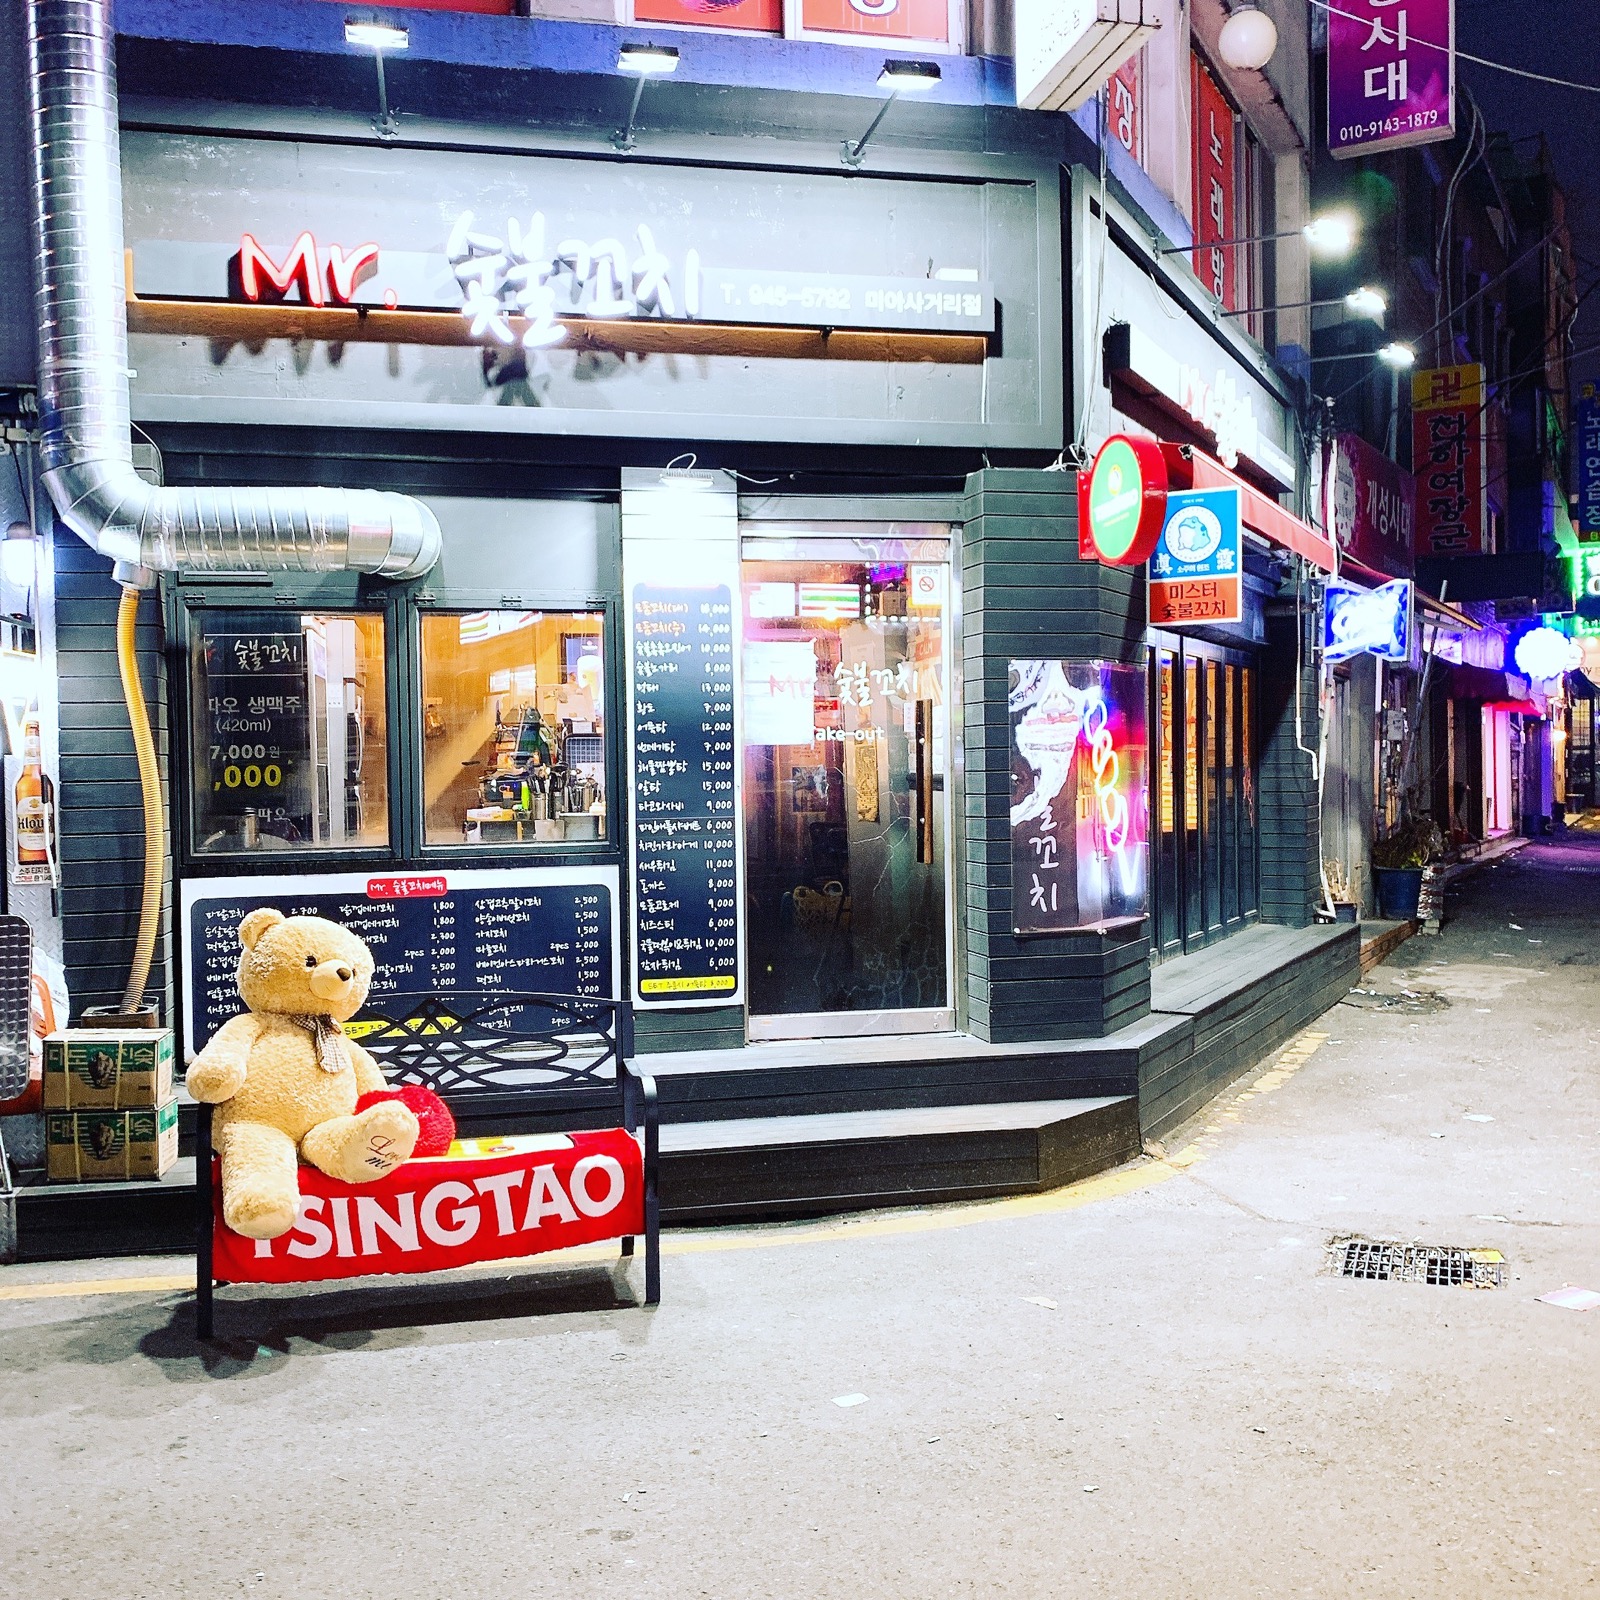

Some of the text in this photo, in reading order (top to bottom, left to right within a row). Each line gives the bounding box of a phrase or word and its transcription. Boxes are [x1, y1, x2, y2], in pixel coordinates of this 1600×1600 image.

[1360, 0, 1408, 101] 시대
[1339, 109, 1438, 141] 010-9143-1879
[241, 210, 700, 348] Mr. 숯불꼬치
[864, 288, 983, 317] 미아사거리점
[1366, 479, 1411, 548] 개성시대
[1169, 582, 1217, 599] 미스터
[1161, 600, 1226, 620] 숯불꼬치
[234, 640, 297, 672] 숯불꼬치
[701, 643, 730, 656] 10,000
[834, 661, 918, 707] 숯불꼬치
[247, 696, 303, 715] 생맥주
[636, 700, 731, 716] 황도 7,000
[215, 719, 272, 733] (420ml)
[637, 721, 731, 736] 어묵탕 12,000
[814, 726, 886, 741] ake-out
[637, 740, 731, 755] 번데기탕 7,000
[637, 760, 732, 776] 해물짬뽕탕 15,000
[214, 764, 282, 792] ,000
[637, 780, 732, 796] 알탕 15,000
[638, 800, 732, 813] 타코와사비 9,000
[18, 816, 53, 829] Klou
[707, 820, 732, 834] 6,000
[639, 840, 733, 852] 치킨가라아게 10,000
[639, 860, 733, 872] 새우튀김 11,000
[370, 879, 444, 895] Mr. 숯불꼬치메뉴
[639, 879, 734, 894] 돈까스 8,000
[433, 902, 454, 913] 1,800
[475, 896, 598, 910] 삼겹고추말이꼬치 2,500
[708, 899, 734, 912] 9,000
[205, 908, 245, 921] 파닭꼬치
[475, 911, 598, 925] 양송이버섯꼬치 2,500
[433, 917, 455, 928] 1,800
[640, 918, 734, 931] 치즈스틱 6,000
[475, 926, 598, 938] 가지꼬치 1,500
[475, 941, 599, 956] 마늘꼬치 2pcs 2,000
[706, 938, 734, 951] 10,000
[404, 947, 455, 959] 2pcs 2,000
[431, 963, 455, 974] 2,500
[575, 956, 599, 967] 2,500
[641, 957, 735, 971] 감자튀김 6,000
[578, 970, 599, 982] 1,500
[432, 978, 455, 989] 3,000
[576, 985, 599, 997] 3,000
[207, 1003, 240, 1015] 새우꼬치
[552, 1017, 570, 1026] 2pcs
[344, 1026, 365, 1036] SET
